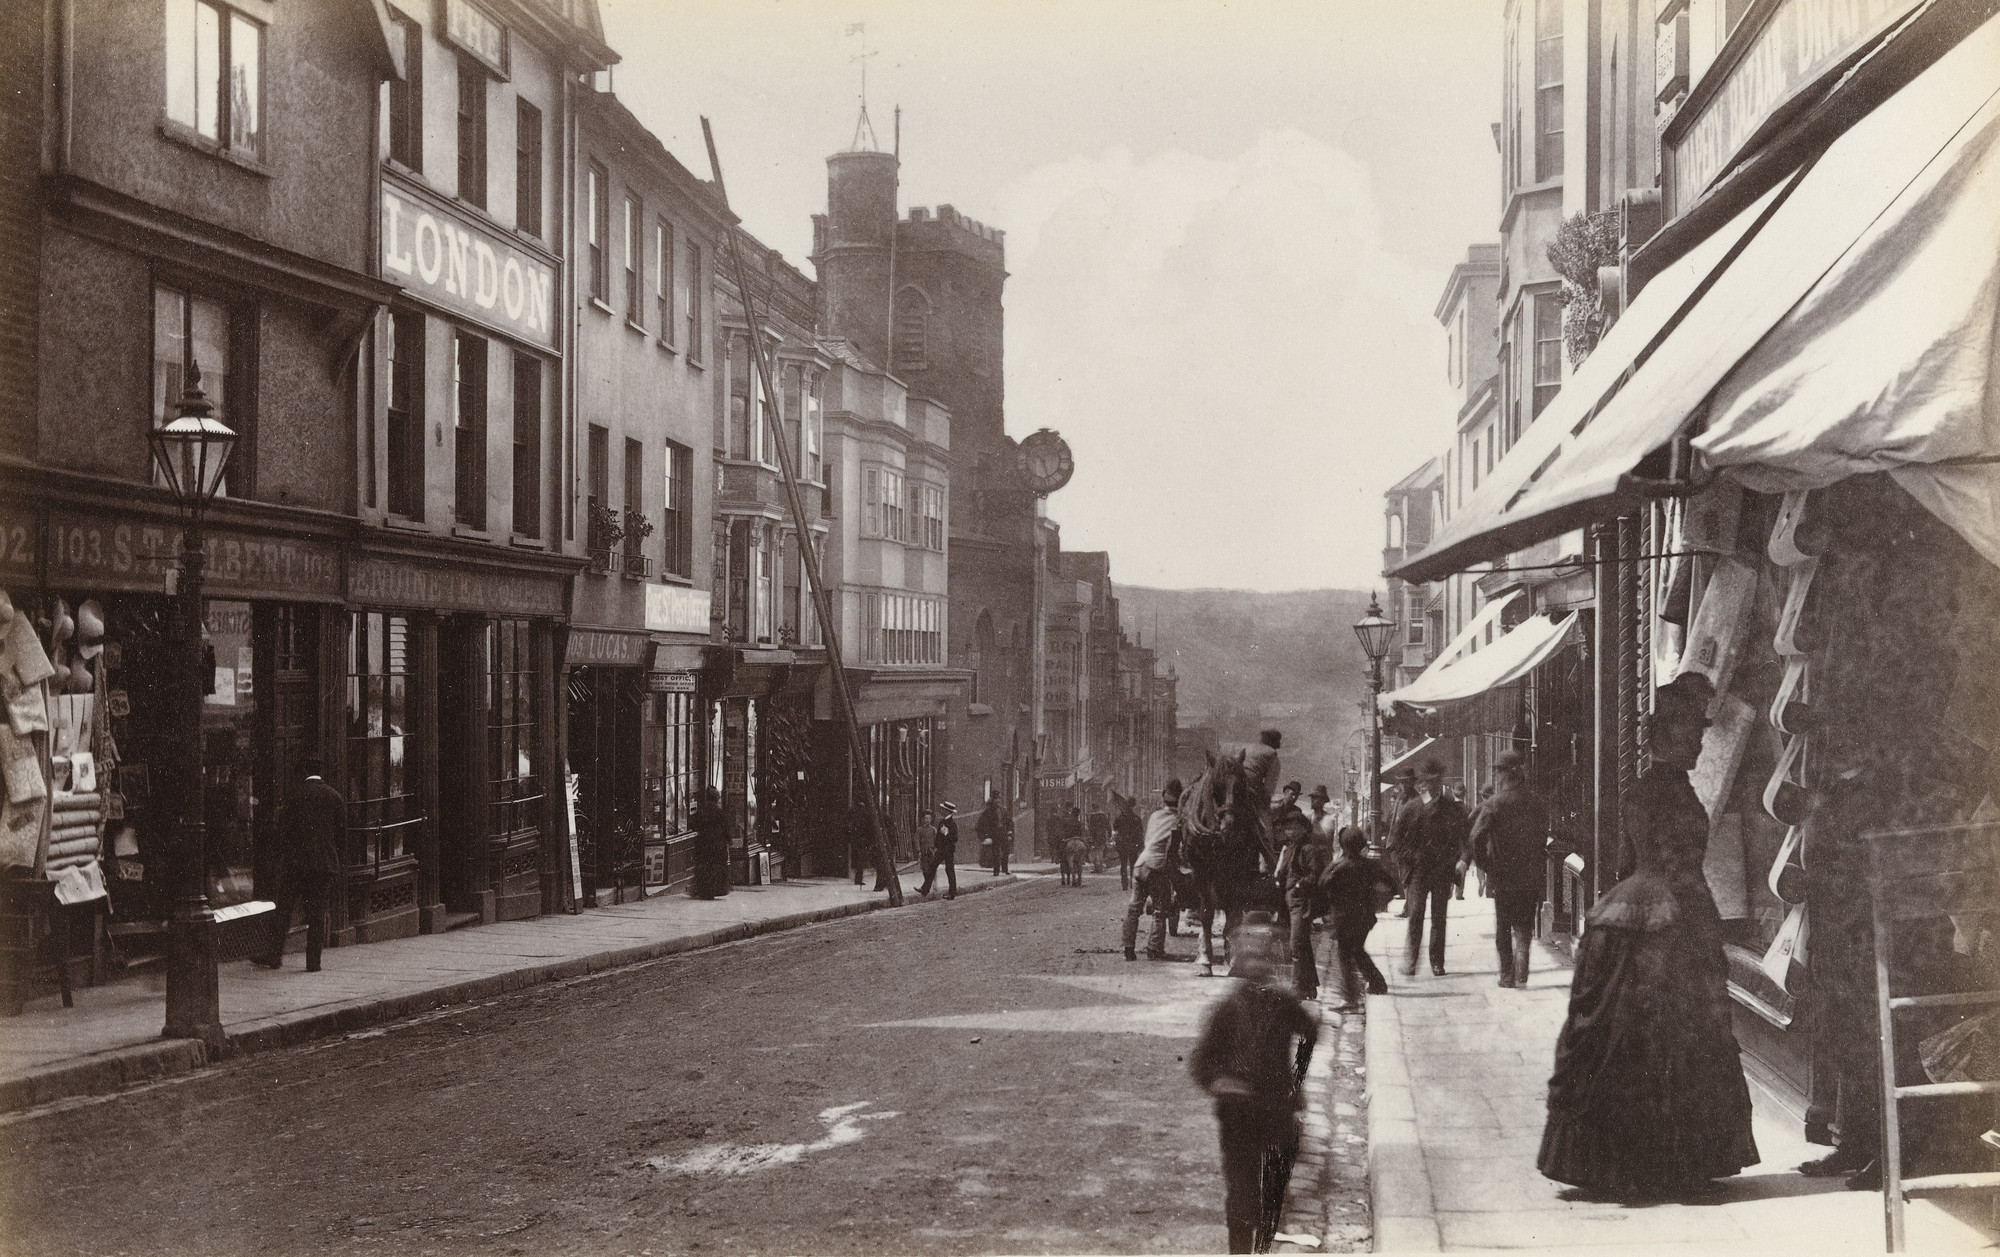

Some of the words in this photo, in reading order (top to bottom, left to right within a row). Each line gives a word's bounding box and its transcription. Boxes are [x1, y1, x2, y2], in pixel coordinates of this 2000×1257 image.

[386, 193, 550, 333] LONDON
[57, 525, 107, 566] 103.
[588, 632, 630, 660] LUCAS.
